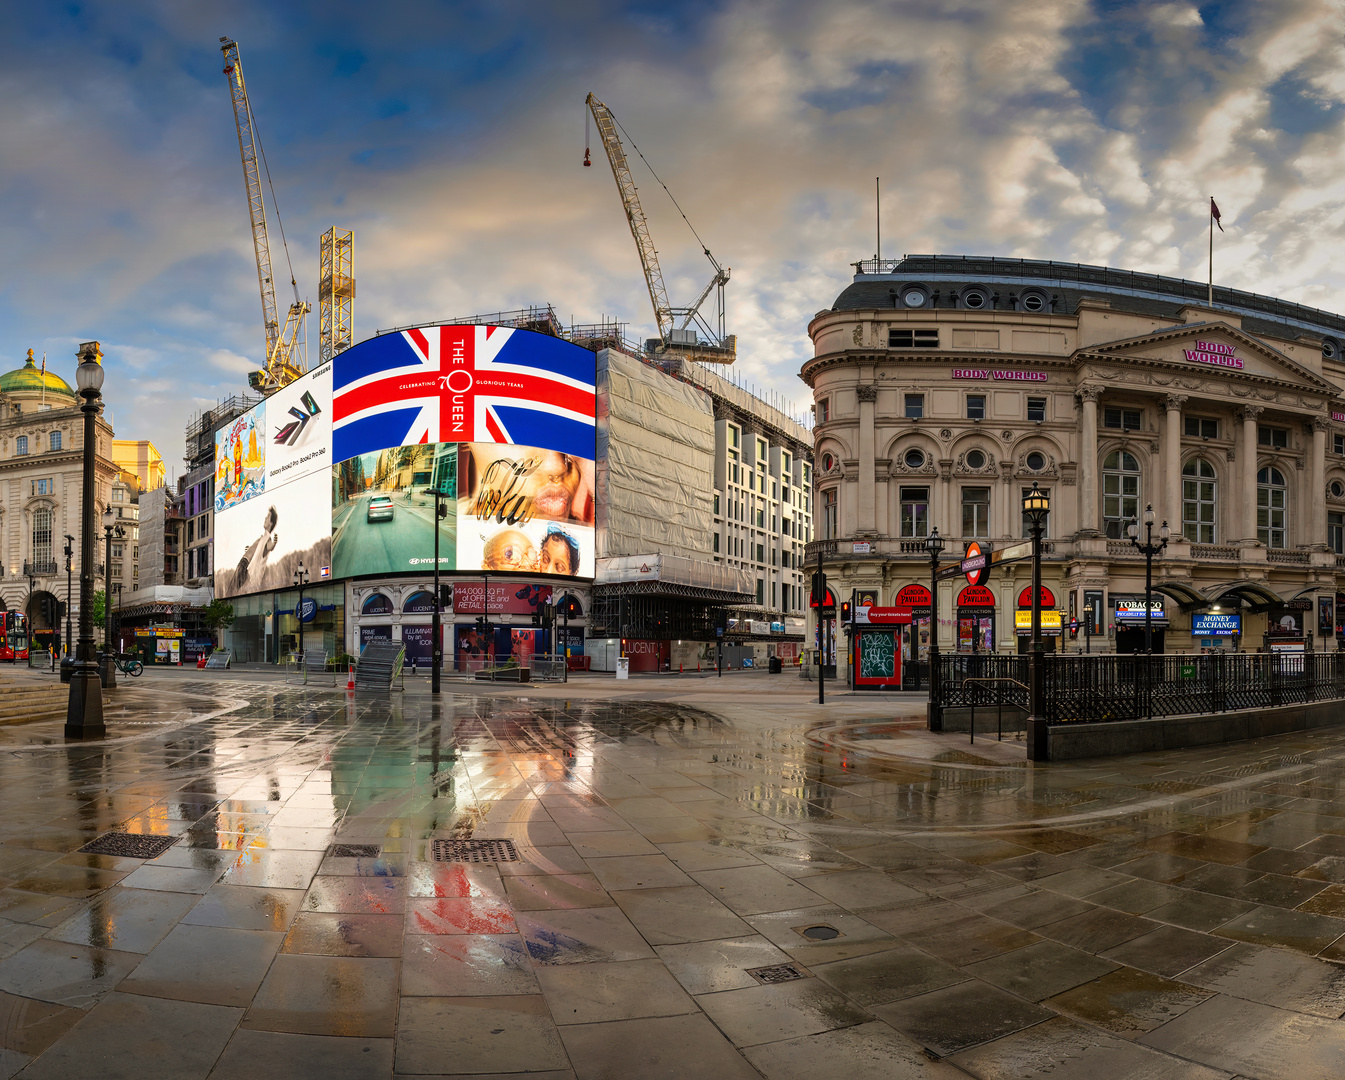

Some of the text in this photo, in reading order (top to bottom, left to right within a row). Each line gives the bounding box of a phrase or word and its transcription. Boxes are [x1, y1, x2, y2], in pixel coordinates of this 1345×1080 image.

[452, 339, 464, 364] THE
[1196, 340, 1235, 356] BODY
[1184, 350, 1244, 369] WORLDS
[312, 365, 331, 380] SAMSUNG
[952, 369, 1047, 382] BODY WORLDS
[399, 381, 435, 389] CELEBRATING
[1332, 412, 1345, 421] BO
[270, 468, 281, 477] Galaxy
[281, 463, 292, 472] Book2
[300, 455, 311, 464] Book2
[318, 448, 326, 457] 360
[962, 558, 986, 569] UNDERGROUND
[462, 594, 469, 602] of
[901, 595, 929, 604] PAVILION
[964, 595, 990, 604] PAVILION
[624, 642, 655, 654] LUCENT
